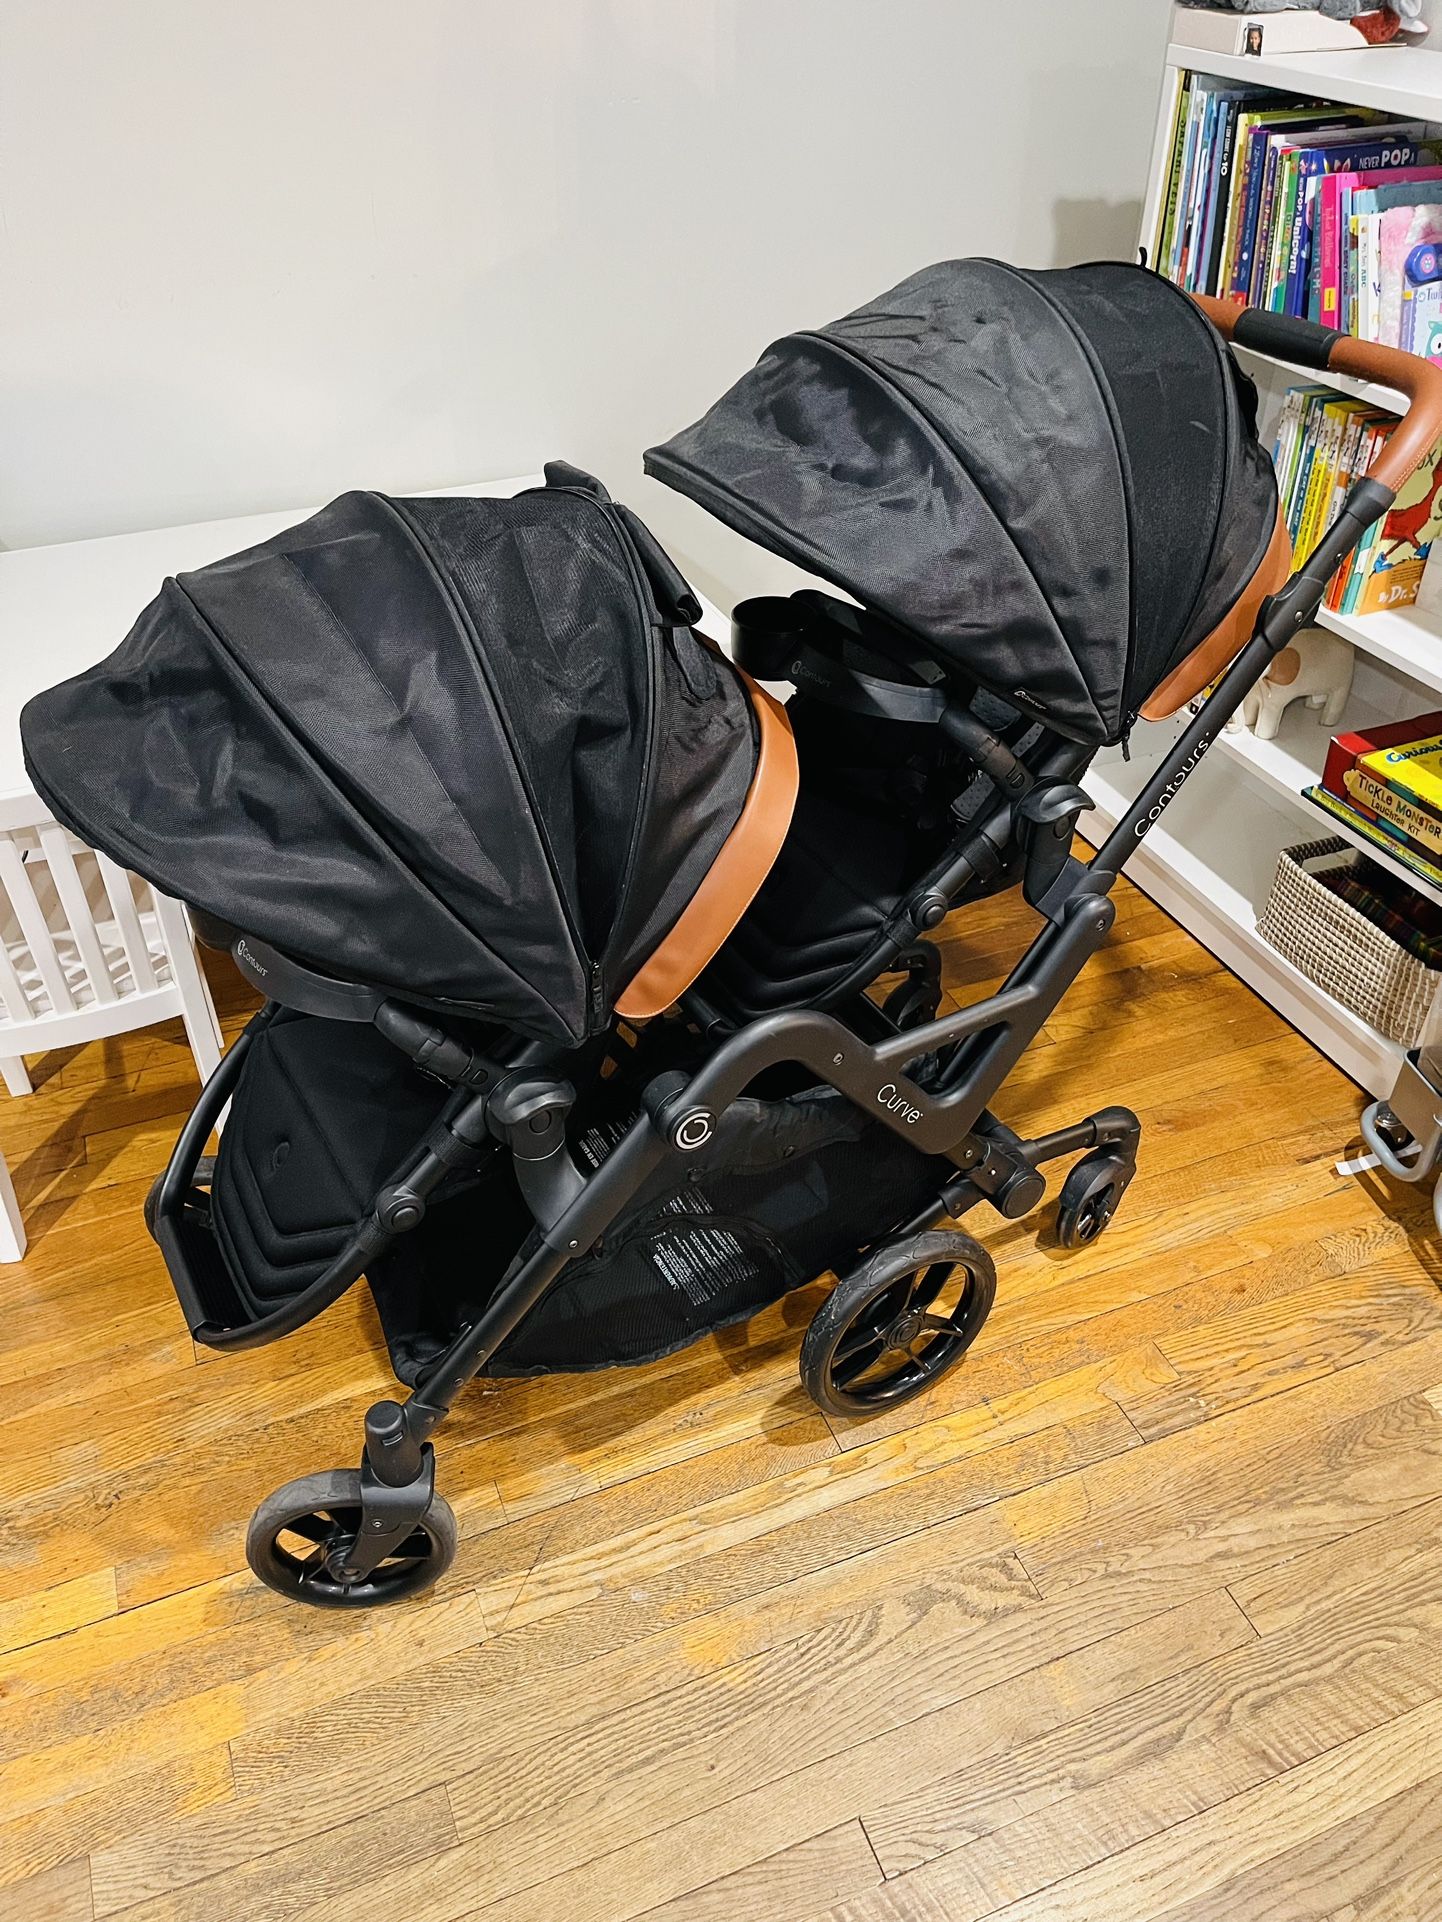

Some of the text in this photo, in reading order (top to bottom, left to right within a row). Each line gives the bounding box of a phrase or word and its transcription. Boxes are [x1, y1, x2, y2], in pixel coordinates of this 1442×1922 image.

[1359, 156, 1380, 169] NEVER
[1381, 148, 1410, 167] POP
[1296, 191, 1304, 211] POP
[1287, 216, 1302, 274] Unicorn!
[1134, 739, 1209, 838] Contours
[1359, 774, 1393, 806] TICKLE
[1395, 801, 1442, 839] MONSTER
[1407, 823, 1420, 836] KIT
[243, 948, 269, 977] Contours
[877, 1084, 920, 1124] Curve
